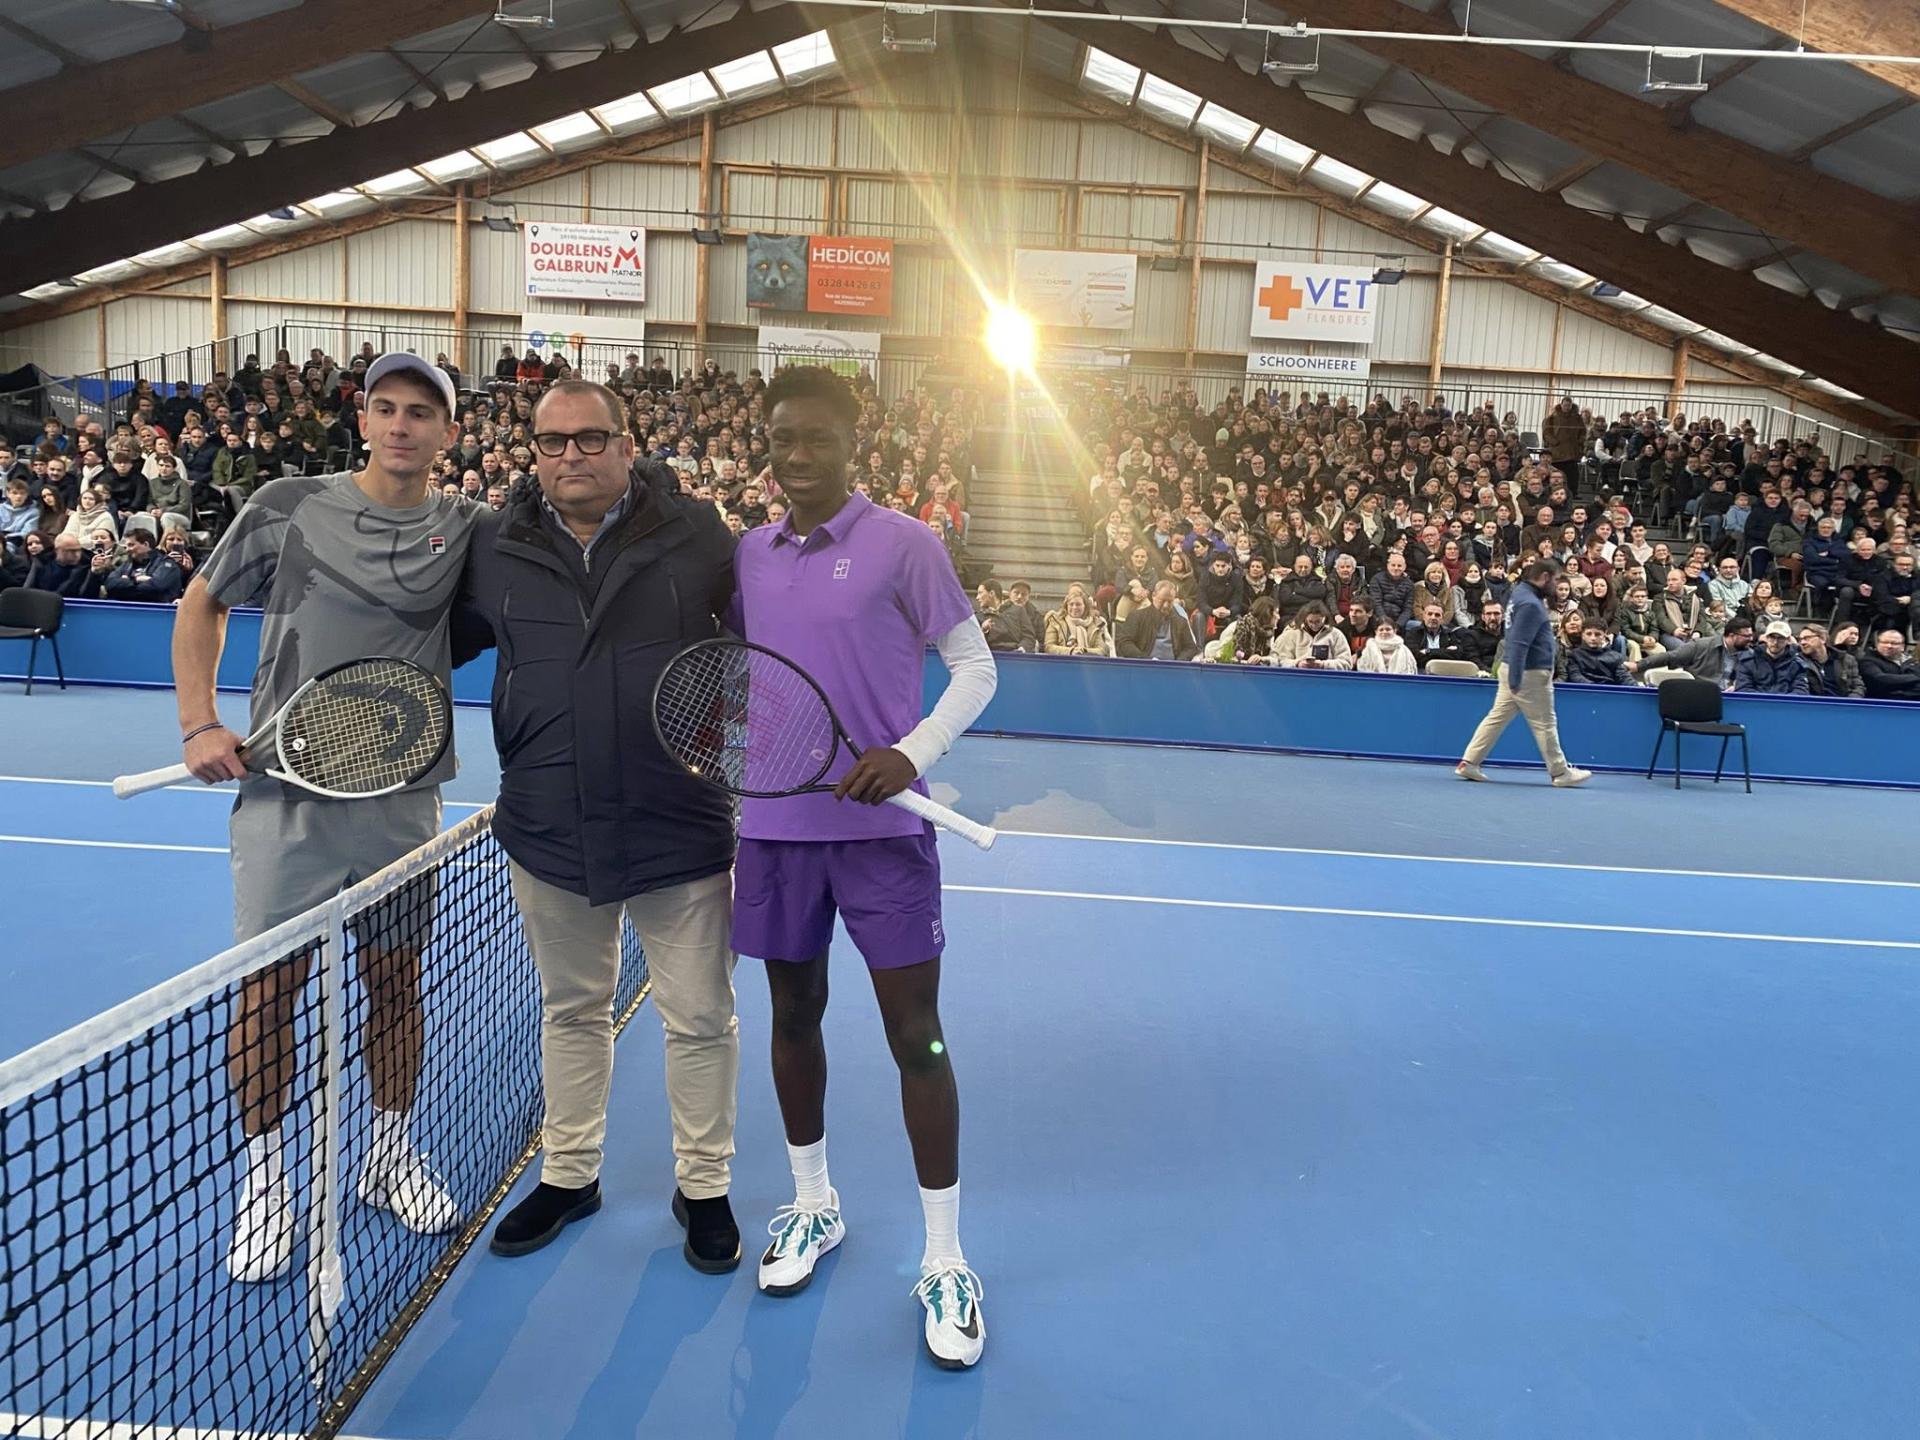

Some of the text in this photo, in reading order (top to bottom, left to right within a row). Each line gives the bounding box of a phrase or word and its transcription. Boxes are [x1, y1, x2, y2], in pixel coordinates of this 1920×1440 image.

[530, 242, 612, 258] DOURLENS
[534, 258, 608, 274] GALBRUN
[612, 269, 642, 277] MATNOR
[1306, 276, 1371, 309] VET
[1307, 312, 1368, 326] FLANDRES
[1259, 355, 1358, 371] SCHOONHEERE
